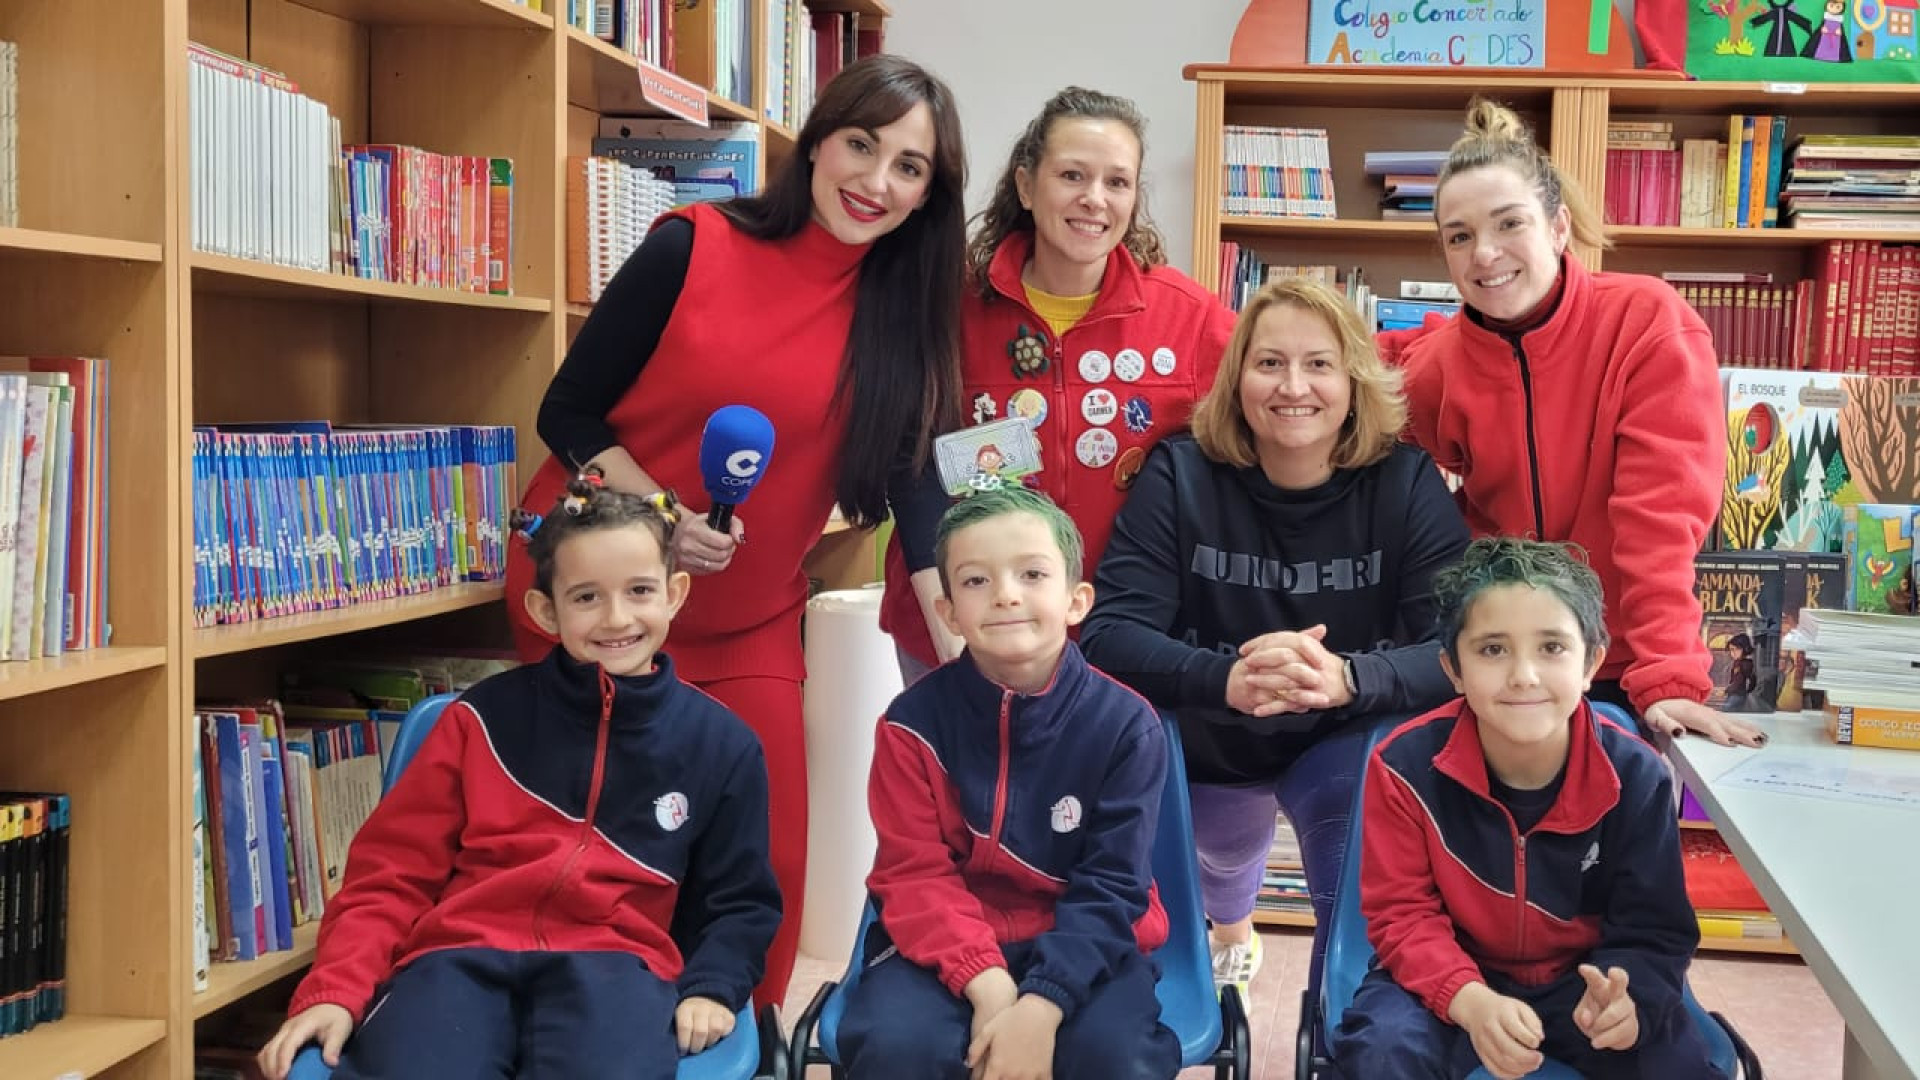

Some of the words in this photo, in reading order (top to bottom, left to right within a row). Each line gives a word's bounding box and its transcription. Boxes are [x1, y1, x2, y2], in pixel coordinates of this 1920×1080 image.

[1326, 32, 1443, 64] Academia
[1448, 34, 1533, 65] CEDES
[1738, 383, 1748, 395] EL
[1751, 383, 1788, 397] BOSQUE
[1196, 544, 1380, 595] UNDER
[1697, 572, 1764, 591] AMANDA
[1700, 590, 1762, 619] BLACK
